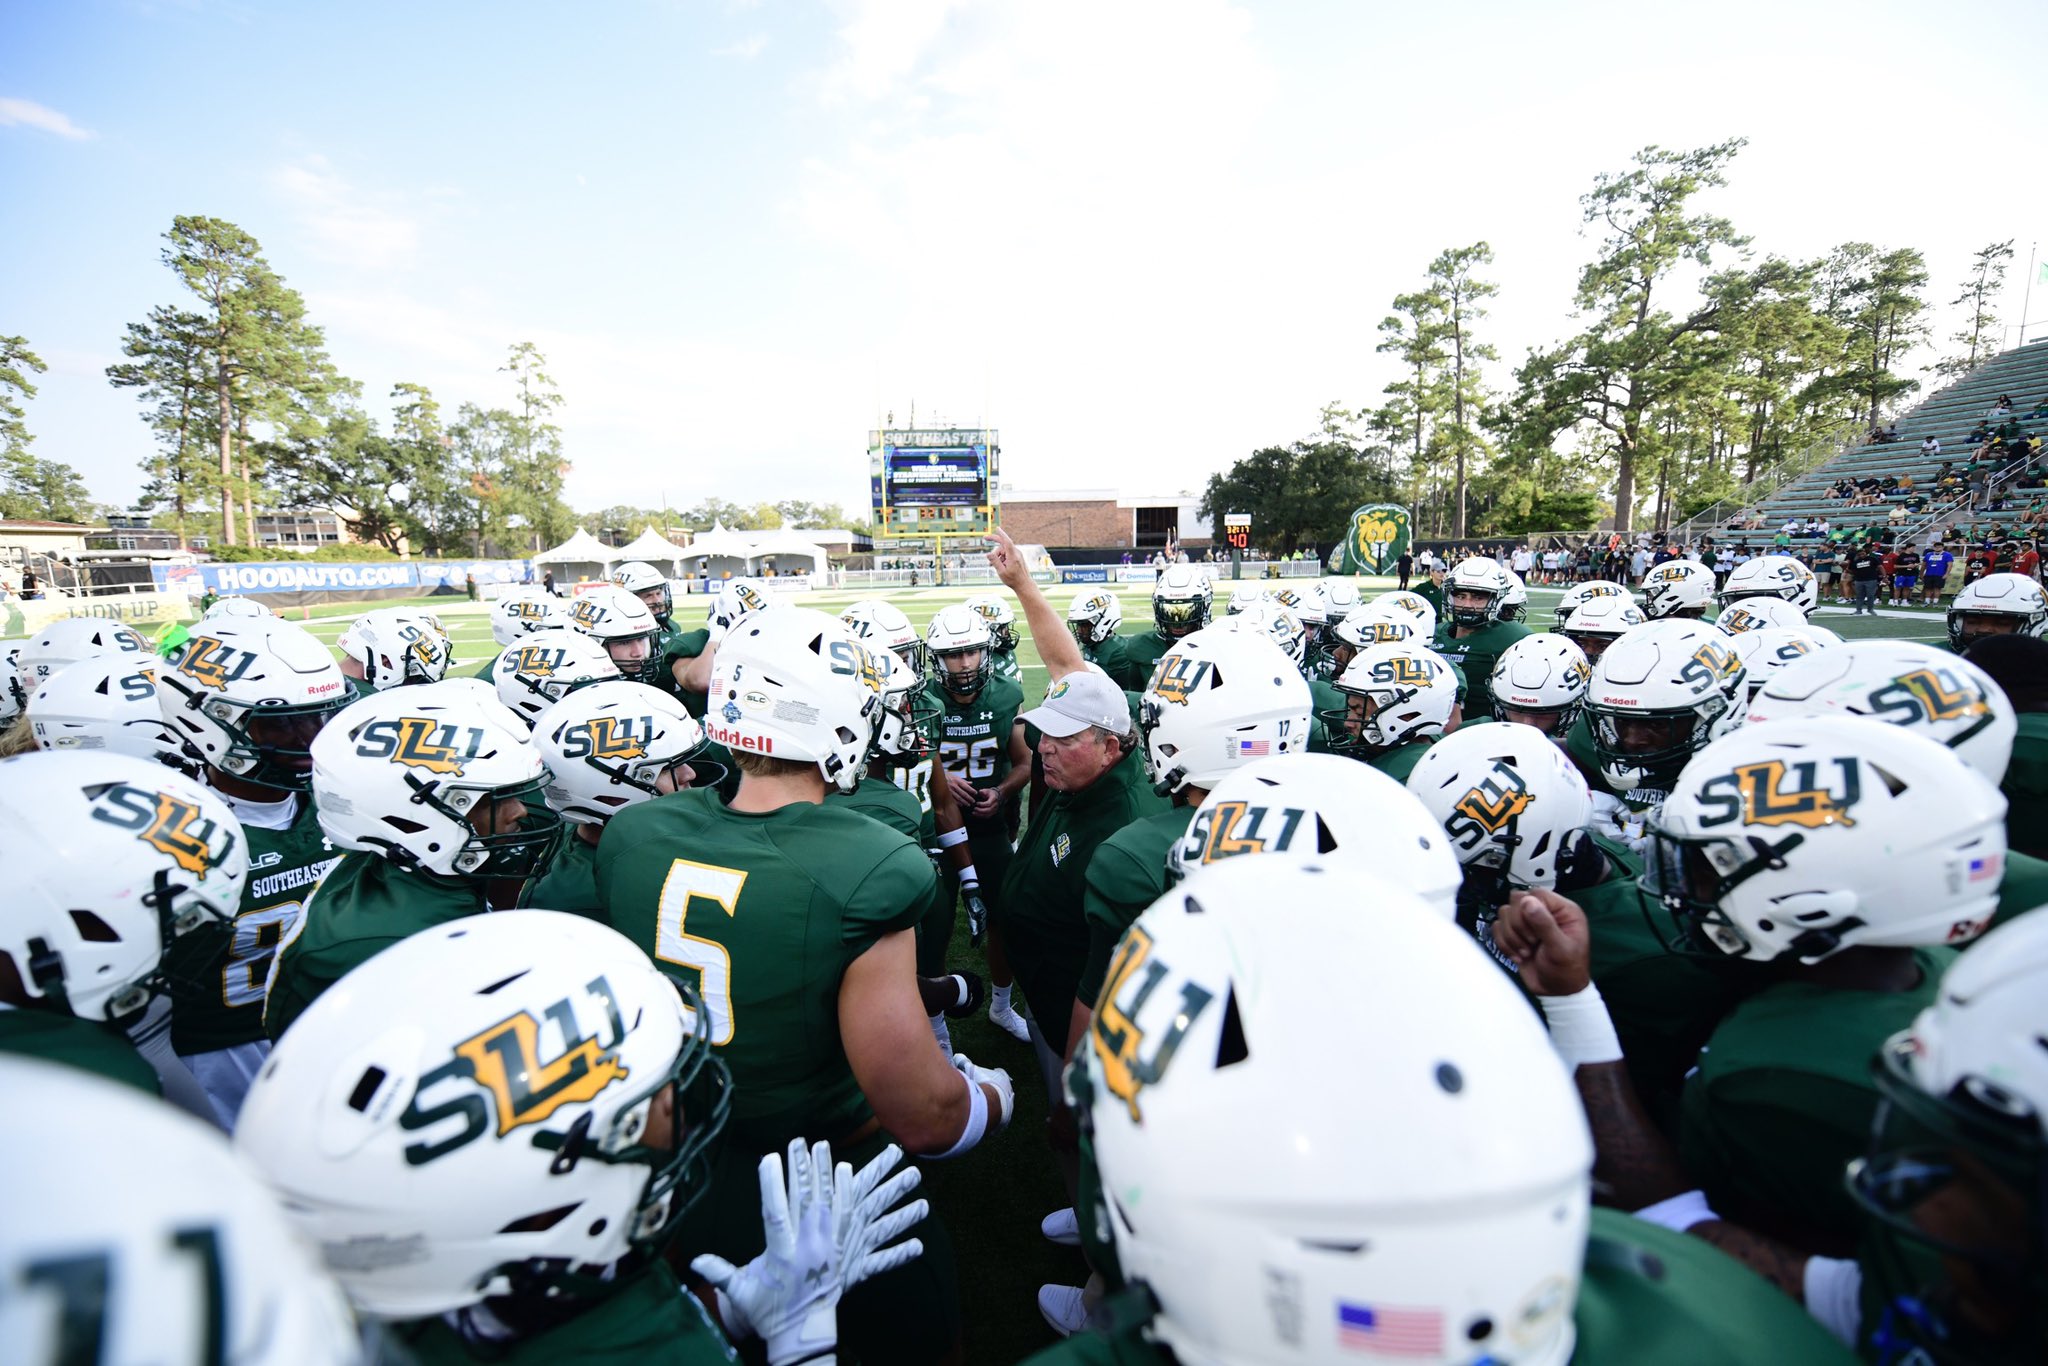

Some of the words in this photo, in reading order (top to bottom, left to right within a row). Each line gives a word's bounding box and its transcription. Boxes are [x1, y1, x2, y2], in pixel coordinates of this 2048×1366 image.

[1228, 534, 1247, 548] 40
[217, 566, 410, 590] HOODAUTO.COM
[1653, 568, 1690, 584] SLU
[736, 586, 767, 611] SLU
[1086, 594, 1112, 612] SLU
[1399, 598, 1424, 612] LU
[1581, 588, 1618, 602] SLU
[67, 603, 122, 619] LION
[130, 600, 159, 618] UP
[507, 602, 548, 618] SLU
[568, 601, 607, 624] SLU
[974, 605, 1000, 617] SLU
[1360, 624, 1407, 643] SLU
[399, 626, 442, 665] SLU
[37, 666, 50, 676] 52
[503, 648, 566, 674] SLU
[1372, 657, 1435, 685] SLU
[733, 665, 743, 682] 5
[1158, 656, 1213, 694] LU
[307, 682, 340, 695] Riddell
[746, 695, 766, 704] SLC
[1511, 695, 1538, 704] Riddell
[1868, 669, 1988, 727] SLU
[1603, 696, 1637, 706] Riddell
[35, 723, 46, 736] 51
[563, 716, 652, 759] SLU
[707, 722, 773, 753] Riddell
[946, 723, 991, 737] SOUTHEASTERN
[1278, 720, 1291, 737] 17
[356, 721, 484, 764] SLU
[939, 737, 998, 779] 26
[1699, 758, 1861, 828] SLU
[1445, 762, 1528, 849] SLU
[92, 786, 236, 868] SLU
[1184, 805, 1305, 861] SLU
[252, 857, 341, 899] SOUTHEAST
[655, 858, 749, 1047] 5
[1097, 938, 1215, 1085] LU
[399, 975, 625, 1166] SLU
